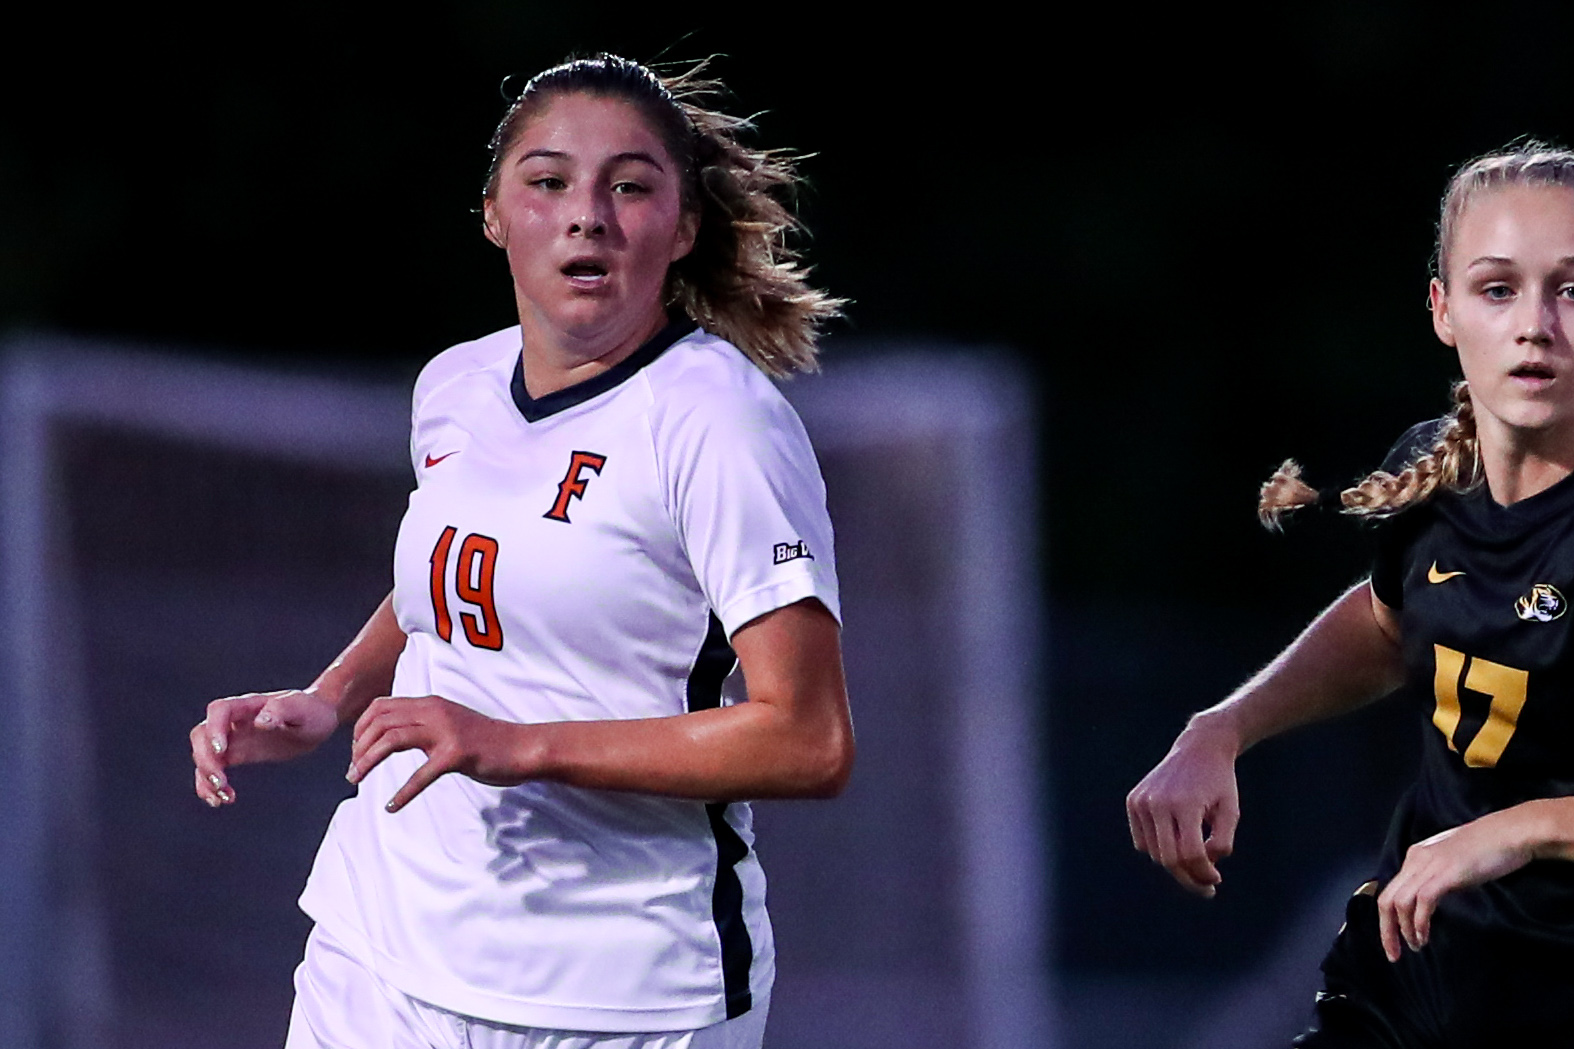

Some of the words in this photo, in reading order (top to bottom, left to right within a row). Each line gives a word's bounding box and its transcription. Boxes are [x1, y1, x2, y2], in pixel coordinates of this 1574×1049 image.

[542, 450, 607, 524] F
[430, 525, 503, 651] 19
[1432, 643, 1529, 768] 17
